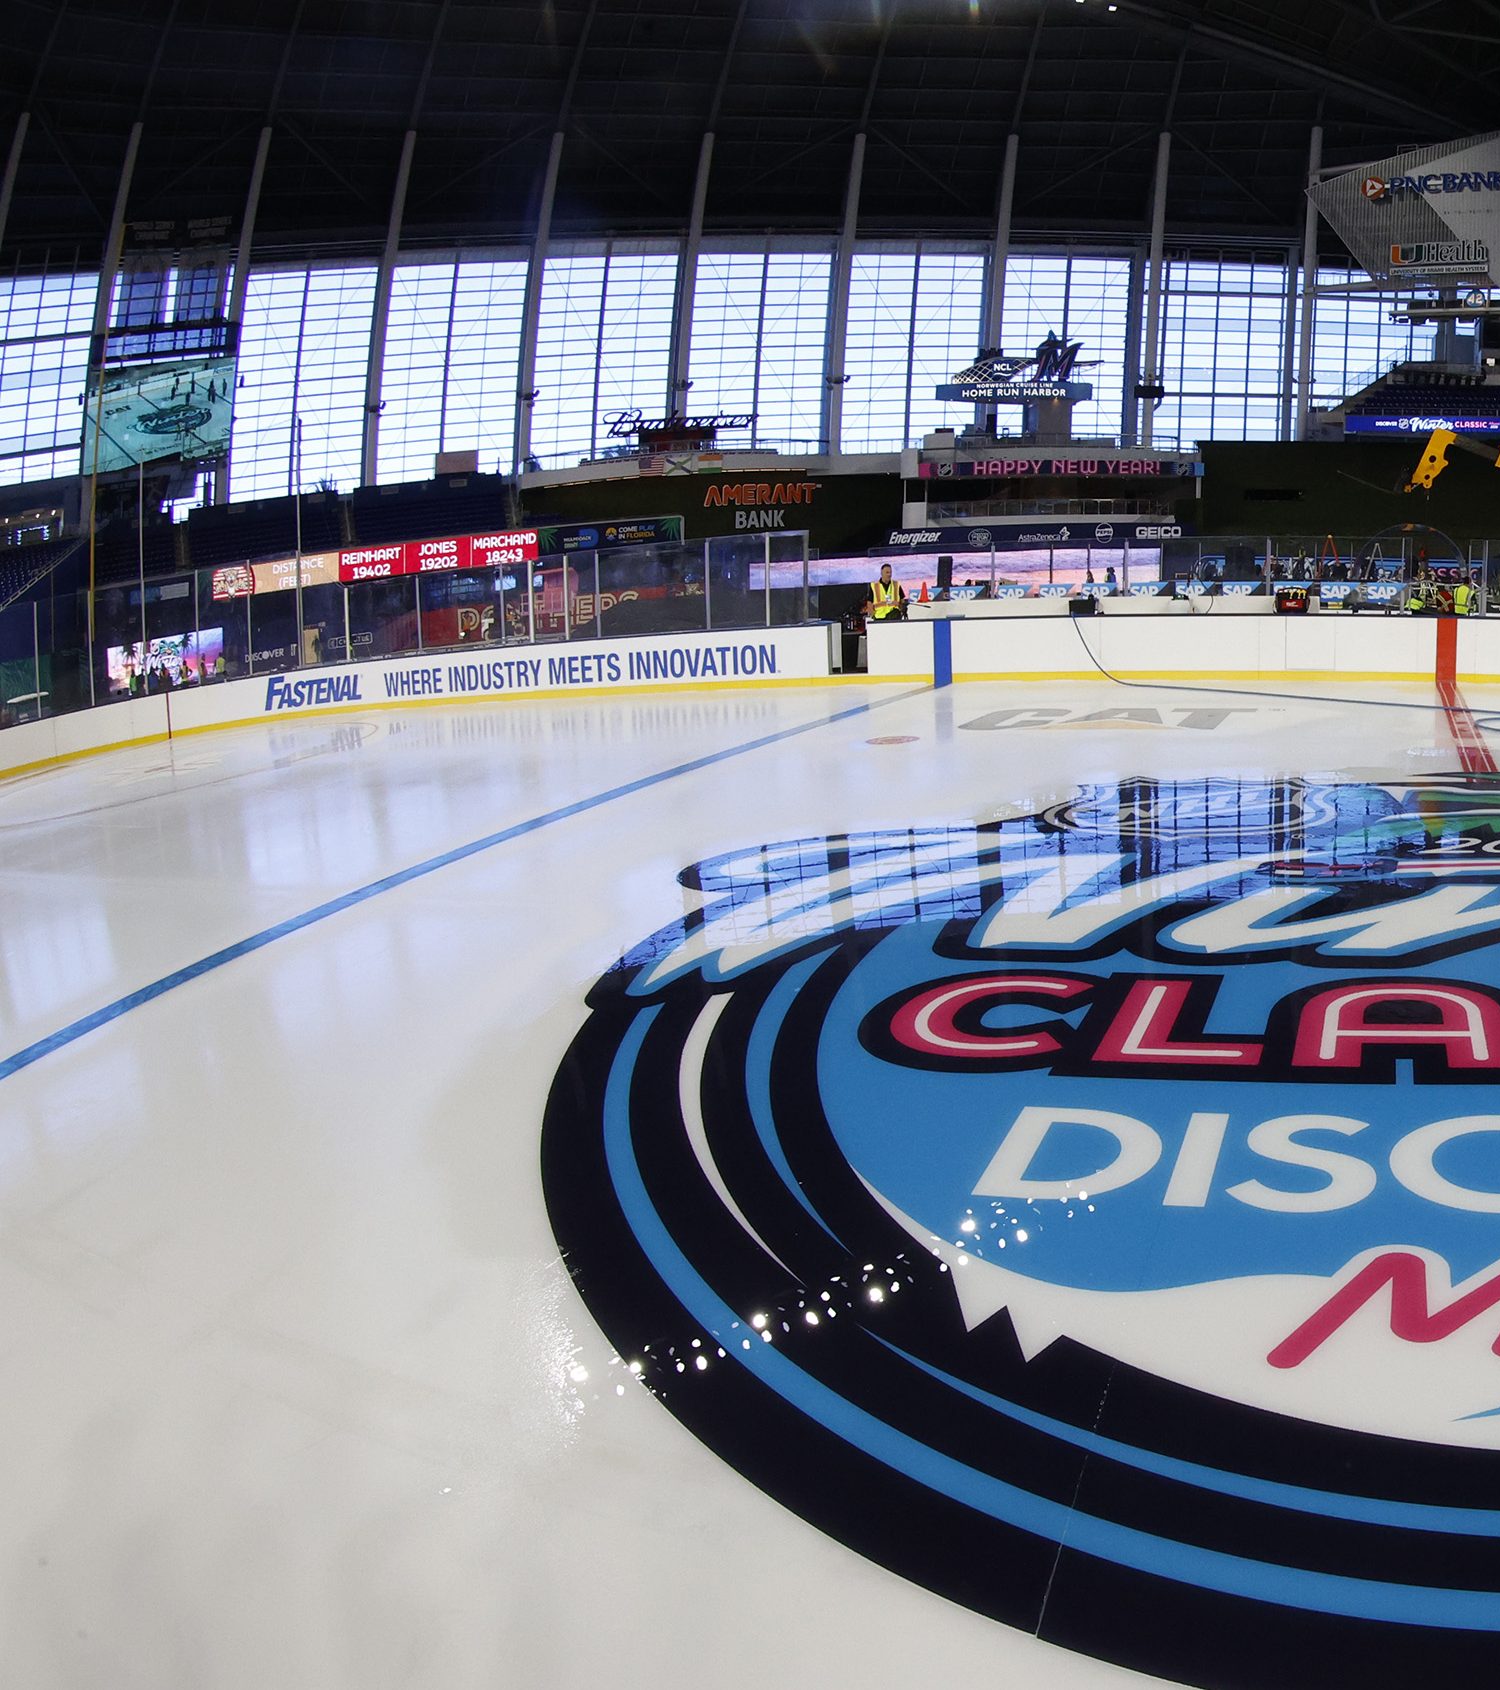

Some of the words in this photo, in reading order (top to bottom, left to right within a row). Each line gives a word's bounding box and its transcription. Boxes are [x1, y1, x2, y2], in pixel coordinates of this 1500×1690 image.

[1466, 293, 1484, 305] 42
[993, 362, 1012, 372] NCL
[962, 388, 994, 398] HOME
[997, 388, 1019, 397] RUN
[1023, 388, 1066, 397] HARBOR
[602, 409, 758, 438] Budweiser
[1409, 417, 1454, 432] Winter
[973, 460, 1042, 476] HAPPY
[1051, 460, 1097, 475] NEW
[1104, 460, 1161, 475] YEAR!
[703, 482, 817, 507] AMERANT
[735, 509, 786, 529] BANK
[618, 525, 638, 533] COME
[638, 524, 656, 532] PLAY
[626, 530, 655, 539] FLORIDA
[1135, 526, 1182, 539] GEICO
[473, 532, 537, 550] MARCHAND
[889, 529, 942, 546] Energizer
[1017, 532, 1061, 543] AstraZeneca
[418, 540, 458, 556] JONES
[341, 547, 402, 566] REINHART
[485, 548, 524, 564] 18243
[420, 557, 458, 571] 19202
[352, 564, 391, 580] 19402
[909, 591, 935, 601] SP
[949, 588, 976, 600] SAP
[998, 588, 1025, 599] SAP
[1040, 587, 1067, 598] SAP
[1082, 586, 1110, 598] SAP
[1130, 585, 1159, 597] SAP
[1175, 584, 1206, 596] SAP
[1222, 585, 1252, 596] SAP
[1320, 585, 1351, 599] SAP
[1367, 585, 1398, 599] SAP
[244, 647, 285, 663] DISCOVER
[265, 674, 362, 711] FASTENAL
[383, 667, 443, 697] WHERE
[448, 658, 542, 692] INDUSTRY
[548, 652, 621, 685] MEETS
[957, 708, 1259, 731] CAT
